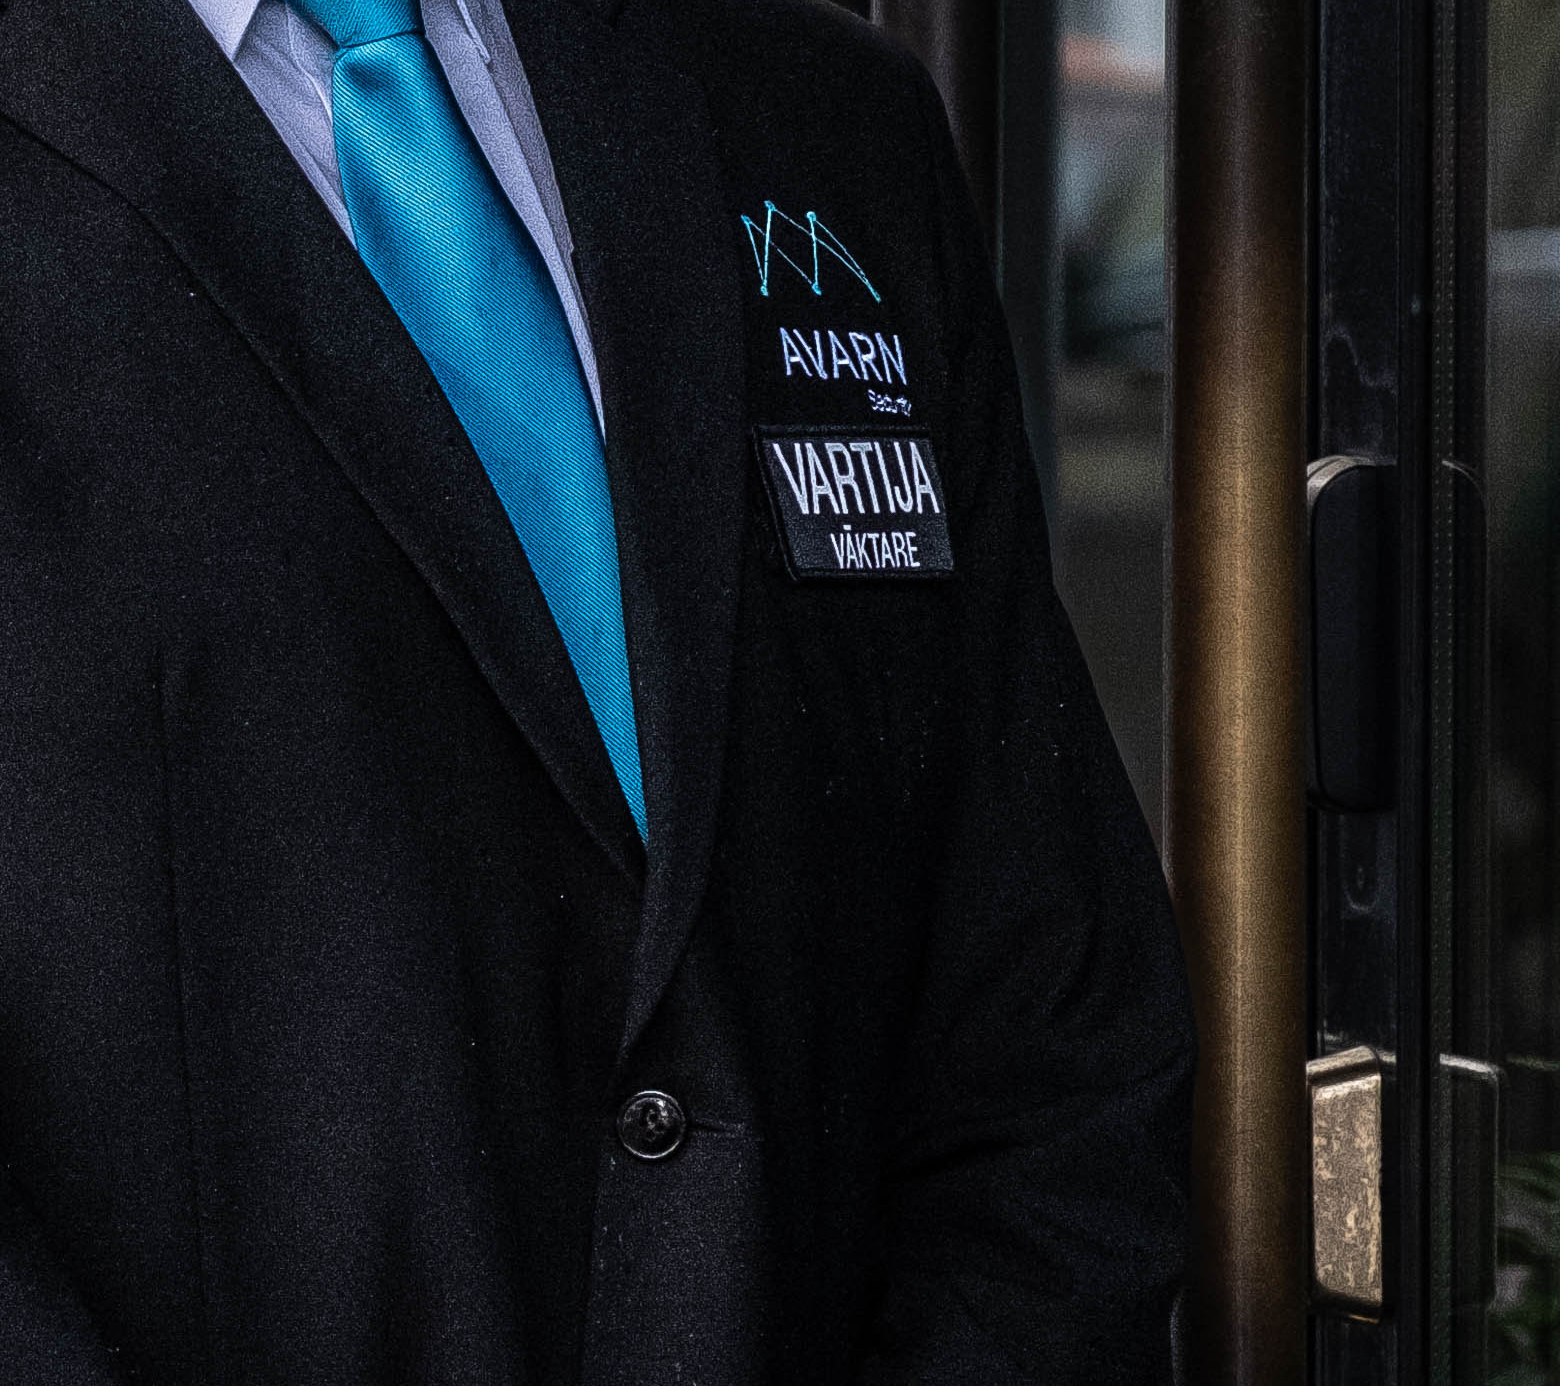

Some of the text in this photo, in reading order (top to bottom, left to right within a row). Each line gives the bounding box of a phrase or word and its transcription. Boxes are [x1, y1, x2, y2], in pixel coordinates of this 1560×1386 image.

[779, 326, 908, 386] AVARN
[772, 441, 940, 515] VARTIJA
[830, 524, 921, 570] VÄKTARE
